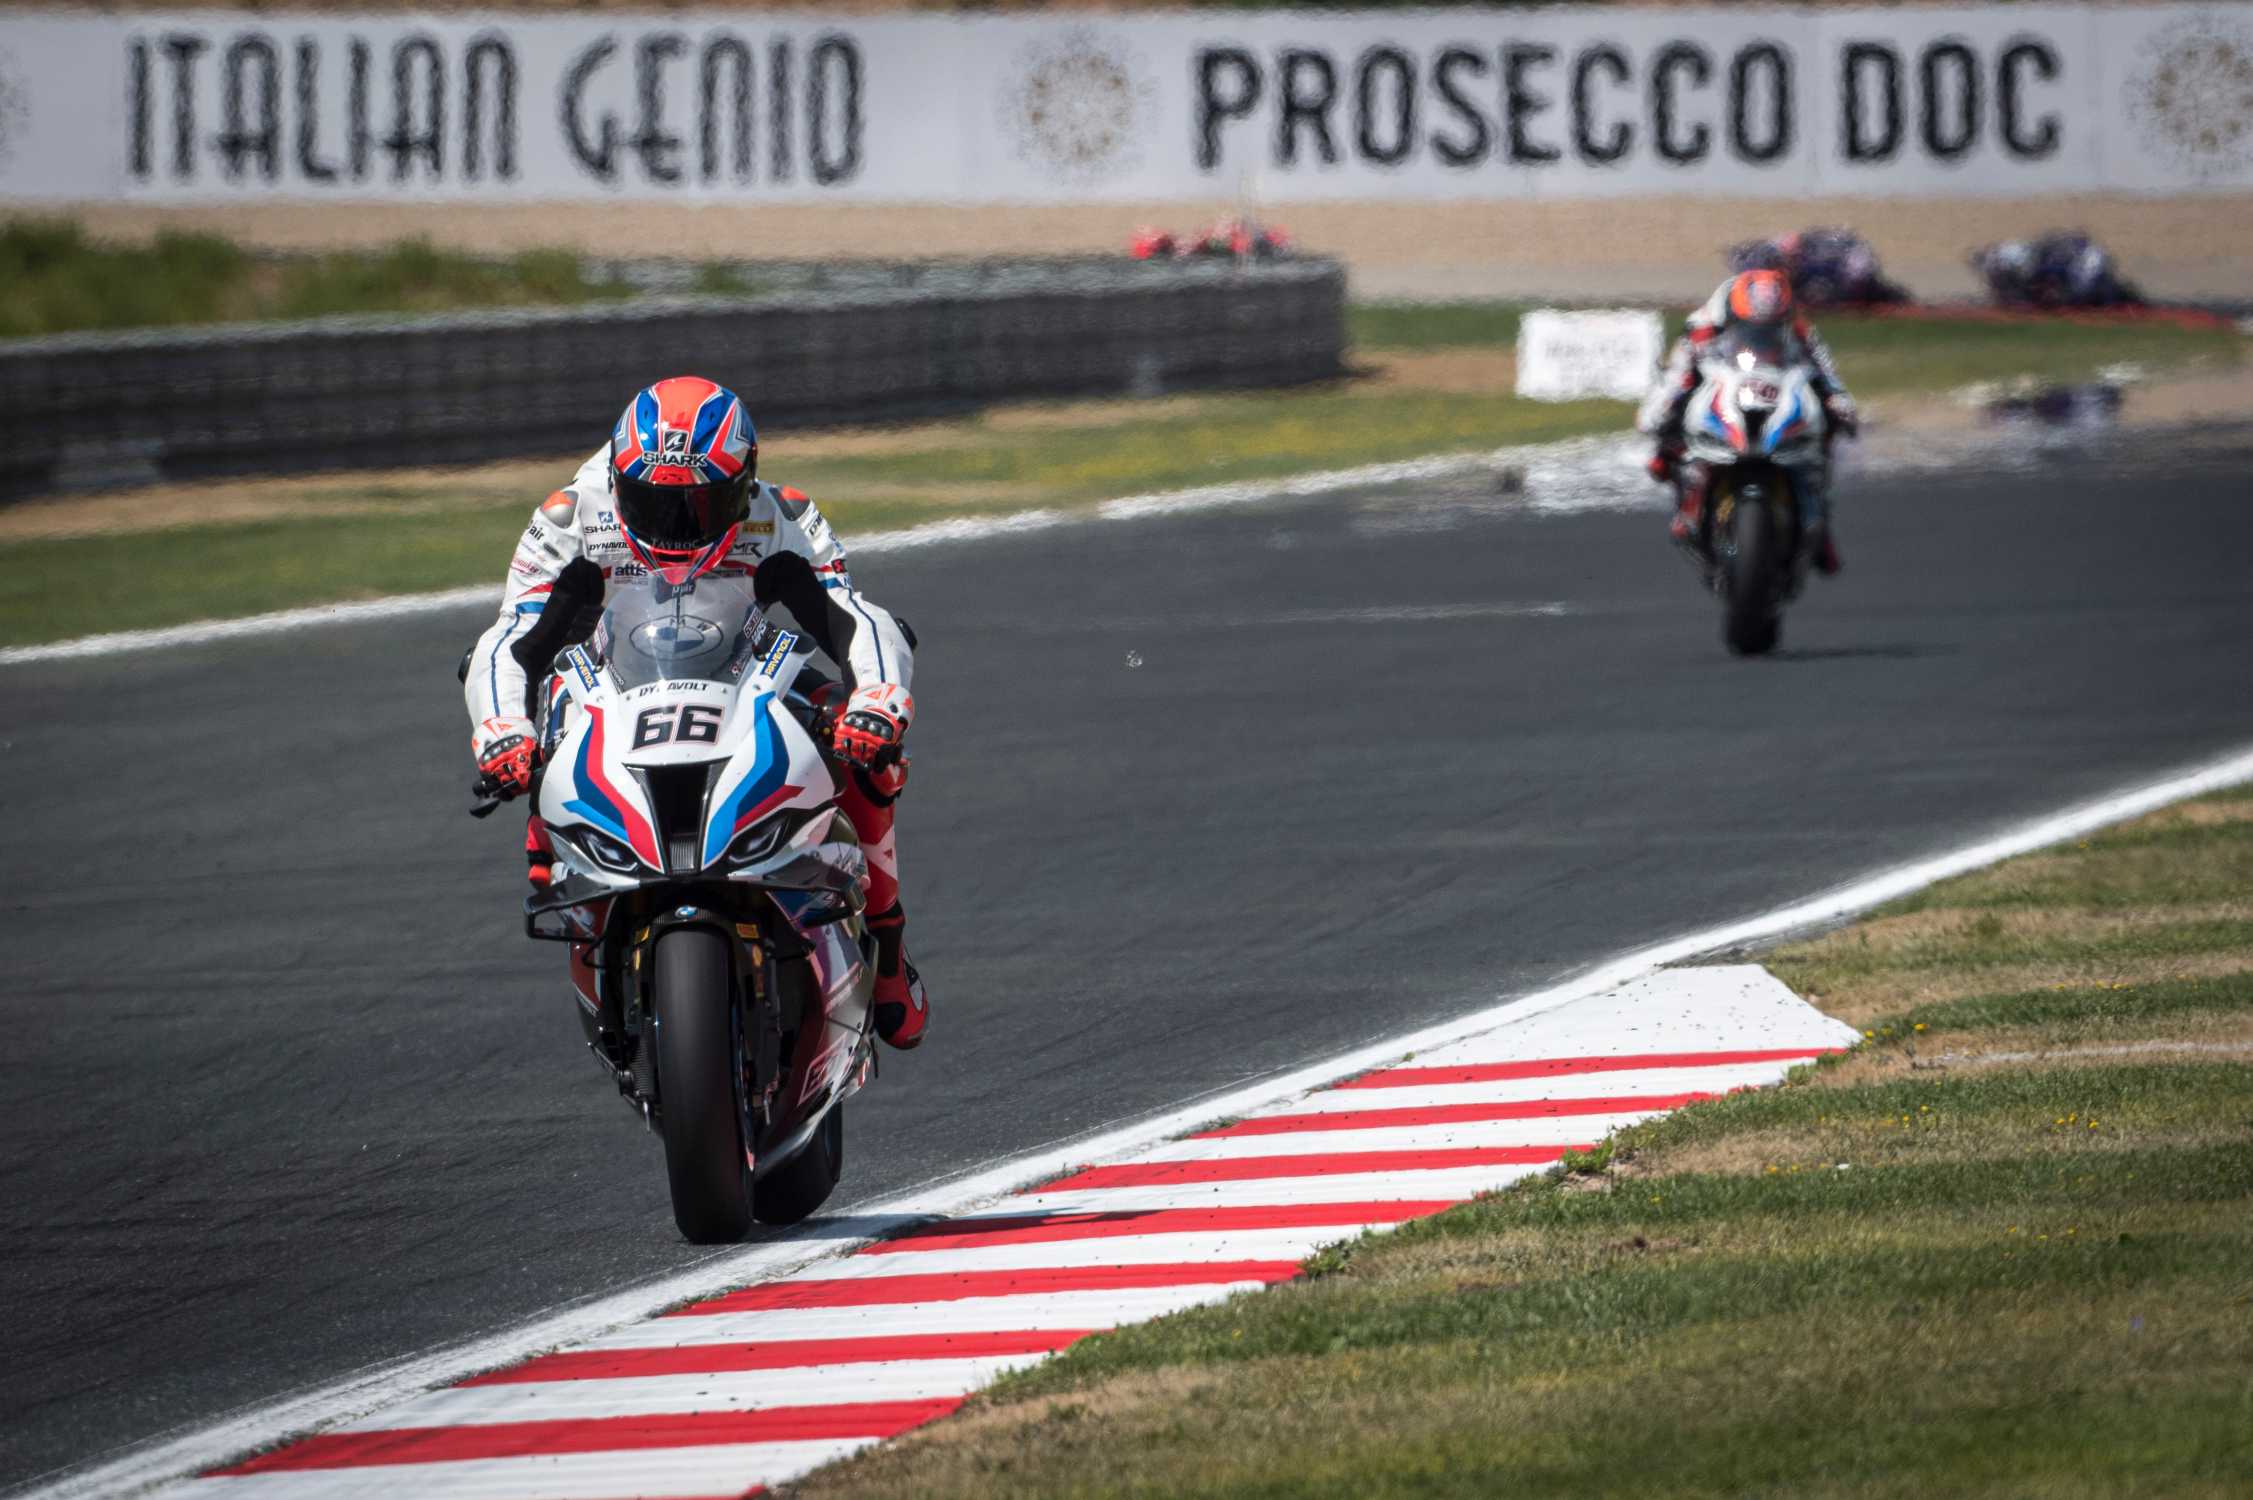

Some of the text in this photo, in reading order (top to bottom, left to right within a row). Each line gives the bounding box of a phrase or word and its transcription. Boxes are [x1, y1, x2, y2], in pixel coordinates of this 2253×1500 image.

[126, 32, 864, 185] ITALIAN GENIO
[1194, 35, 2061, 169] PROSECCO DOC
[642, 452, 708, 468] SHARK
[584, 524, 621, 534] SHAR
[589, 541, 630, 551] DYNAVOL
[615, 563, 648, 577] attis
[639, 682, 709, 697] DYAVOLT
[631, 704, 723, 751] 66
